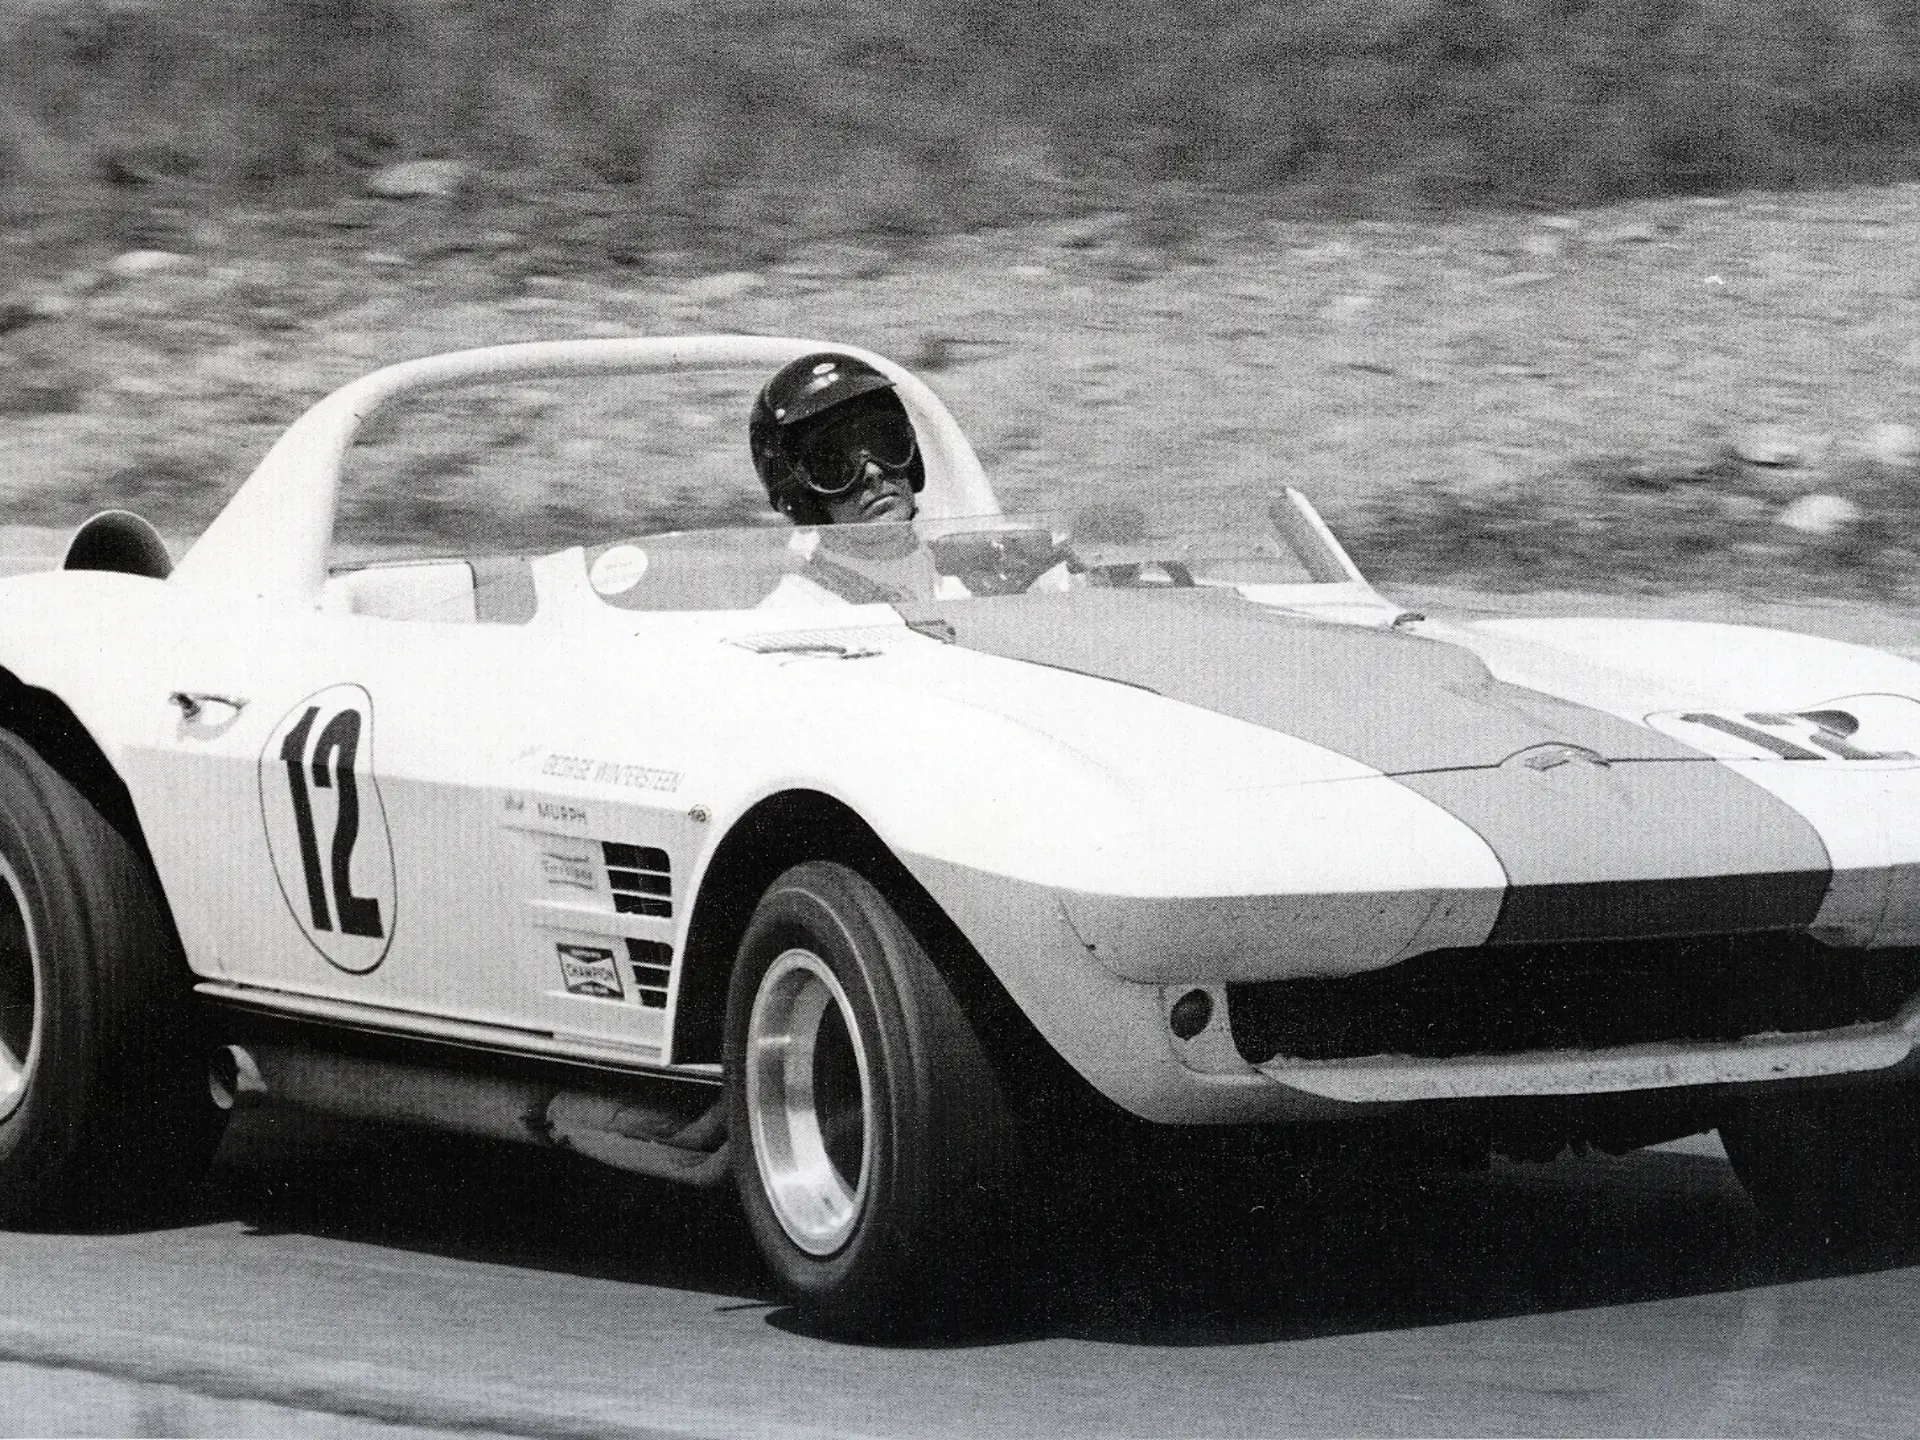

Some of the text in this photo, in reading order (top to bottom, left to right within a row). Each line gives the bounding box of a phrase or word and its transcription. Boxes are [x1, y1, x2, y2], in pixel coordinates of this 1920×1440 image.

[1679, 710, 1918, 760] 12
[541, 753, 595, 781] GEORGE
[280, 706, 384, 938] 12
[565, 963, 615, 982] CHAMPION
